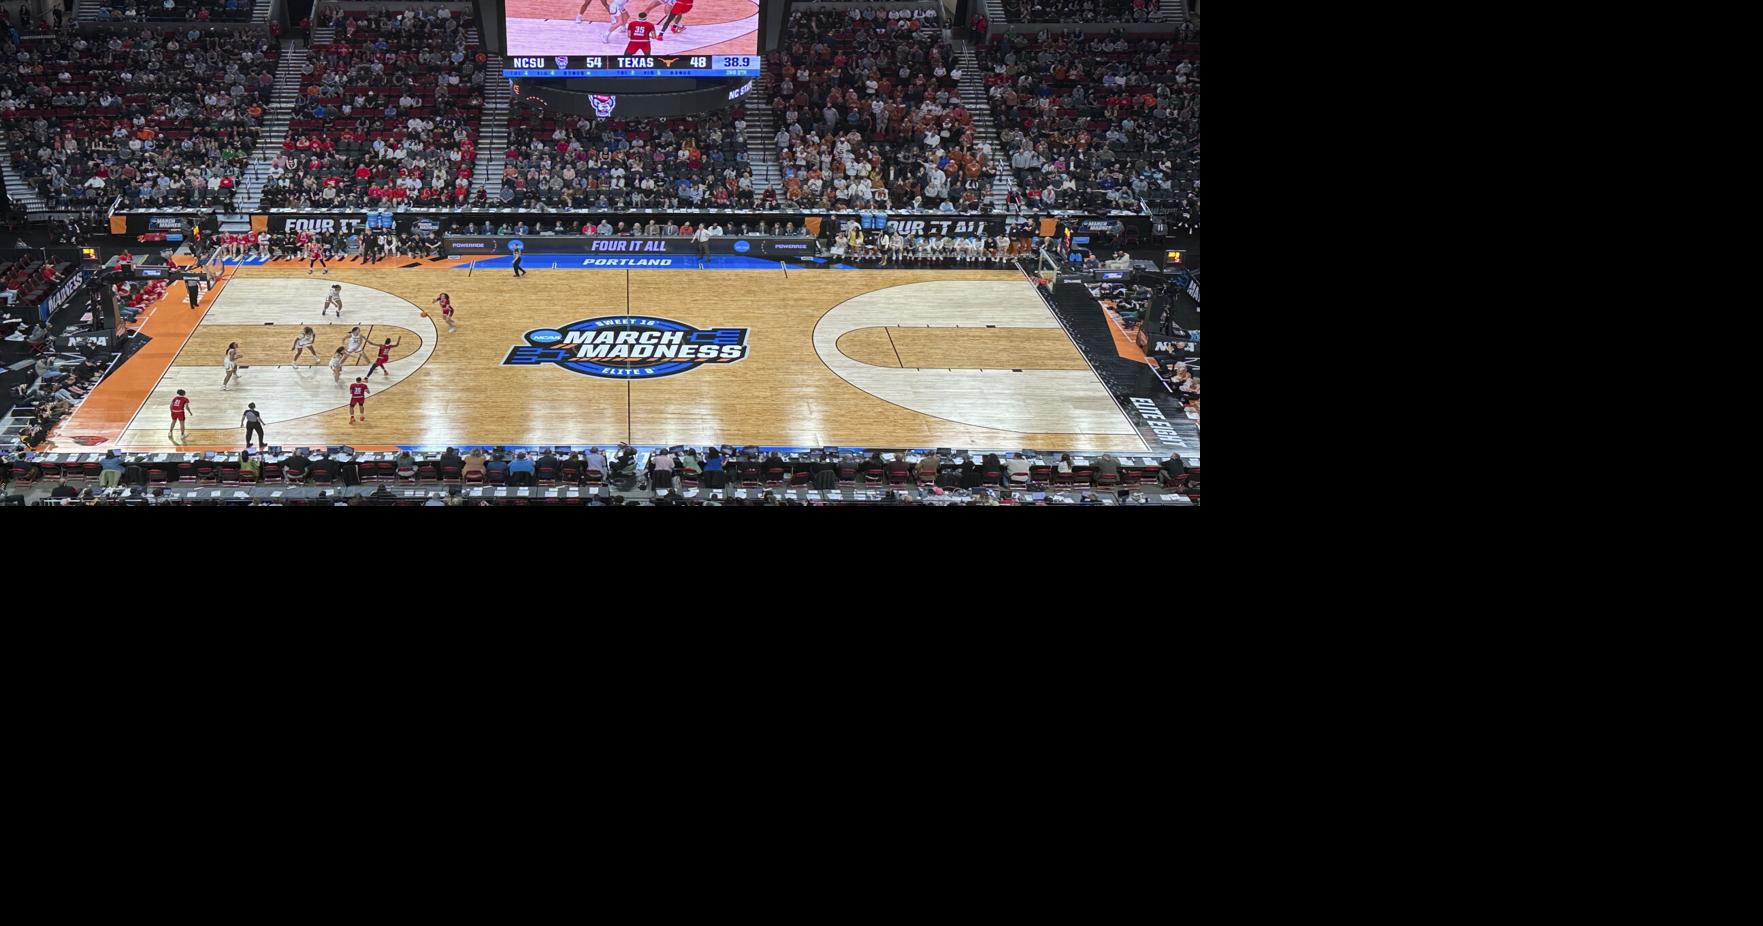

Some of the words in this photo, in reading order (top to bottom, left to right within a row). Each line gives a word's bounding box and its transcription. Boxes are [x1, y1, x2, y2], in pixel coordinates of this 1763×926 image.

[513, 58, 545, 68] NCSU
[586, 58, 602, 68] 54
[617, 57, 654, 68] TEXAS
[690, 57, 707, 68] 48
[723, 57, 750, 67] 38.9
[728, 89, 740, 100] NC
[285, 219, 335, 233] FOUR
[591, 240, 627, 251] FOUR
[629, 240, 642, 251] IT
[643, 240, 667, 251] ALL
[582, 258, 672, 266] PORTLAND
[48, 271, 83, 313] MADNESS
[595, 318, 637, 327] SWEET
[562, 331, 685, 344] MARCH
[576, 344, 744, 358] MADNESS
[602, 367, 641, 375] ELITE
[1129, 397, 1167, 421] ELITE
[1146, 420, 1189, 448] EIGHT
